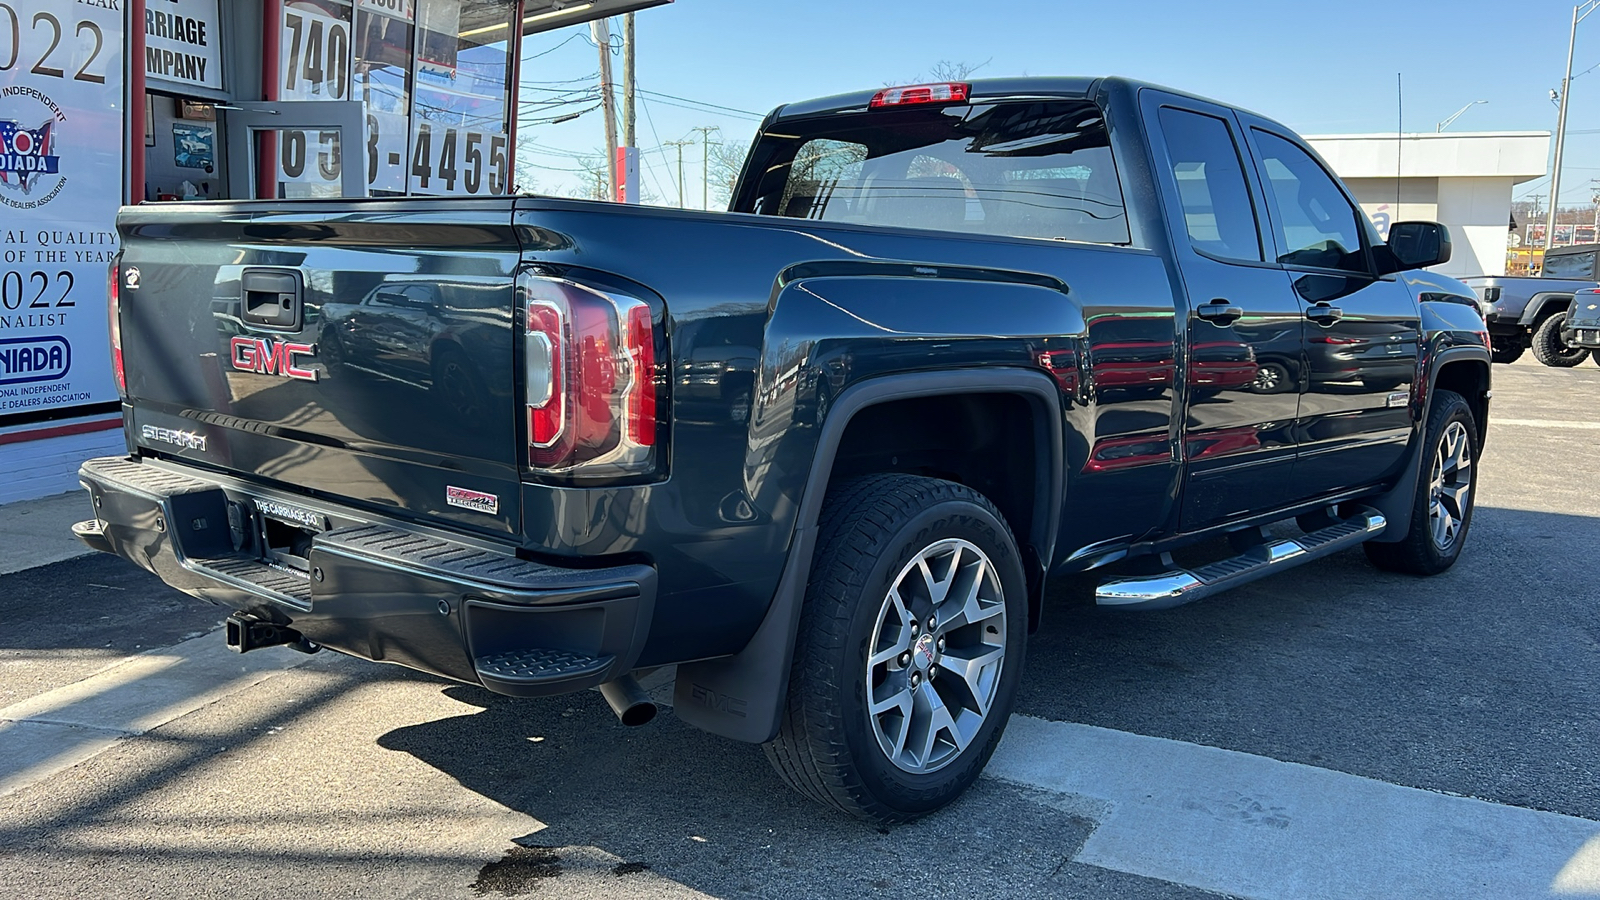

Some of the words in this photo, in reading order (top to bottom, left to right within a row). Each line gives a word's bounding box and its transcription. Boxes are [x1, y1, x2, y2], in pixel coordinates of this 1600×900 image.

[146, 46, 207, 82] MPANY
[286, 13, 347, 99] 740
[2, 86, 67, 122] INDEPENDENT
[10, 199, 37, 209] DEALERS
[37, 176, 67, 207] ASSOCIATION
[37, 230, 117, 247] QUALITY
[4, 250, 27, 263] OF
[34, 250, 67, 263] THE
[74, 250, 114, 263] YEAR
[231, 336, 320, 383] GMC
[9, 397, 41, 409] DEALERS
[42, 392, 91, 405] ASSOCIATION
[20, 382, 71, 396] INDEPENDENT
[142, 424, 208, 452] SIERRA
[692, 682, 748, 718] GMC
